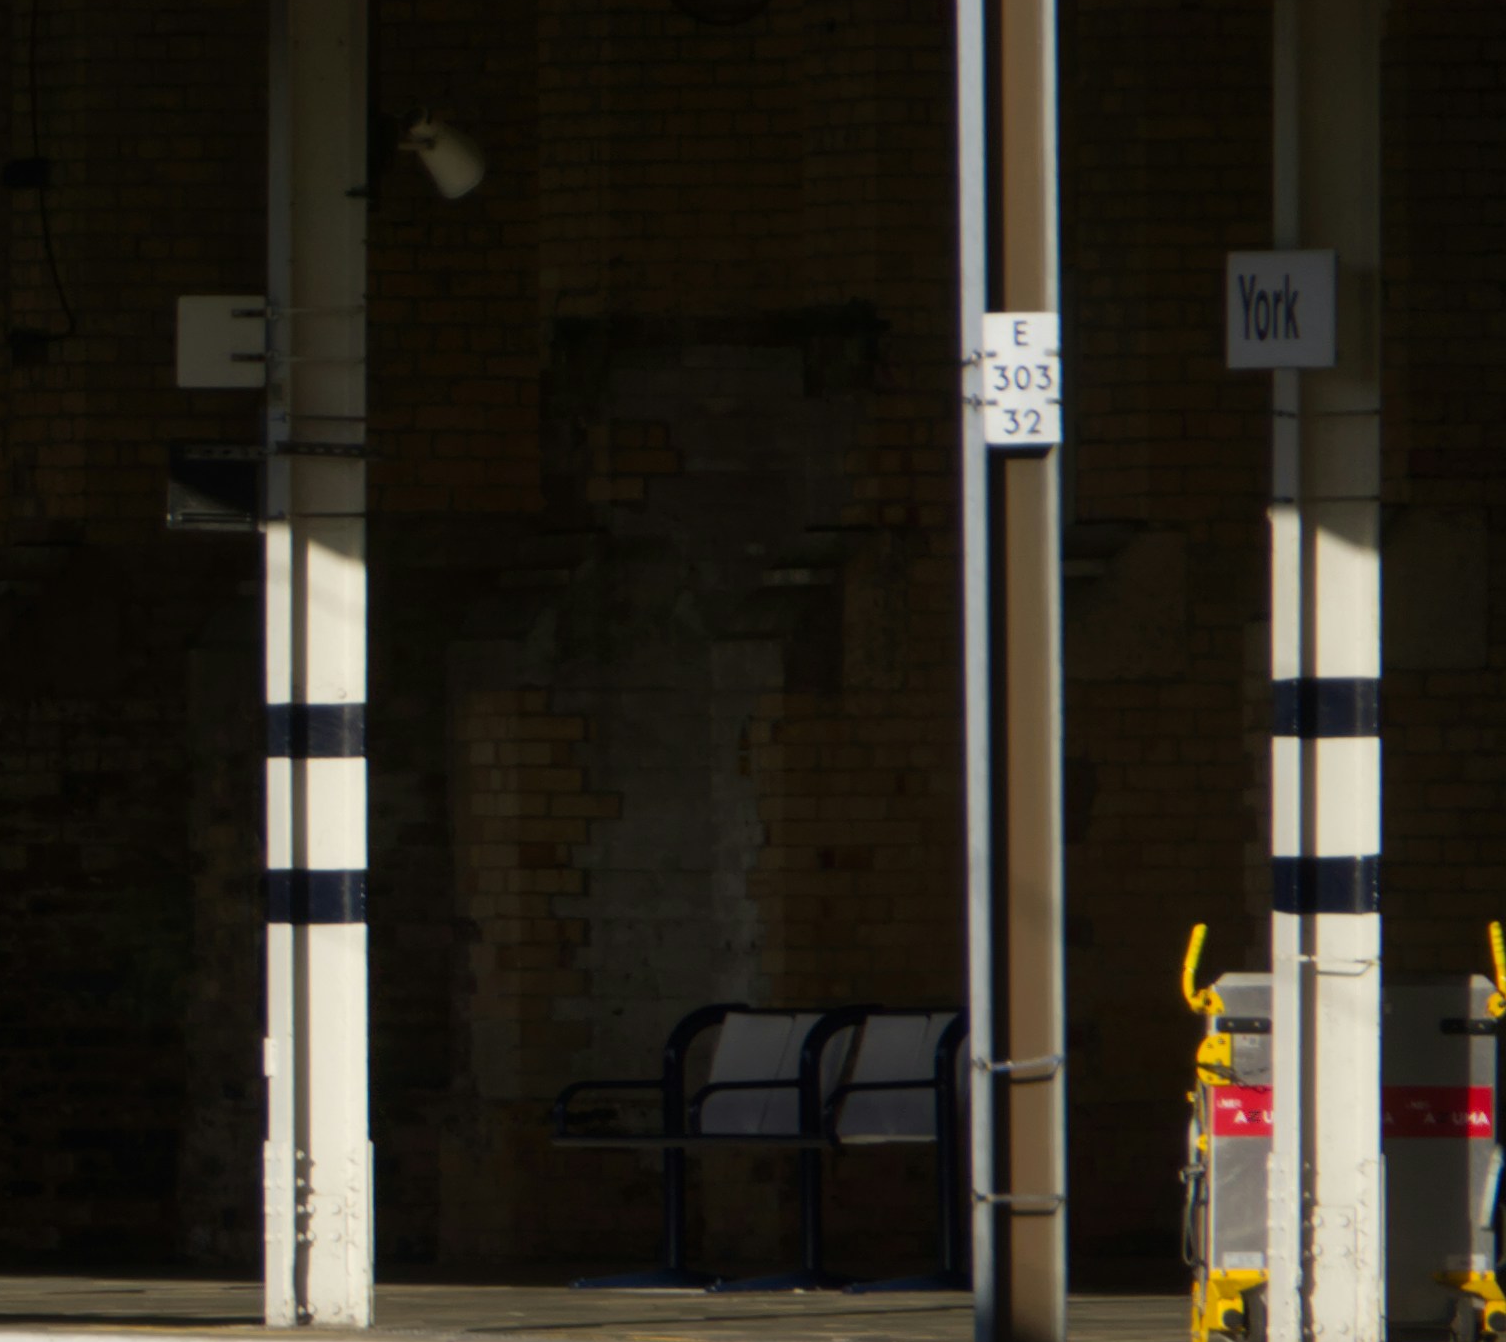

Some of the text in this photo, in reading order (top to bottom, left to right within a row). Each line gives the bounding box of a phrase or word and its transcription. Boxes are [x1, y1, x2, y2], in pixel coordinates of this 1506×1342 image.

[1238, 273, 1300, 341] York
[1012, 320, 1030, 347] E
[992, 364, 1053, 391] 303
[1003, 409, 1042, 435] 32
